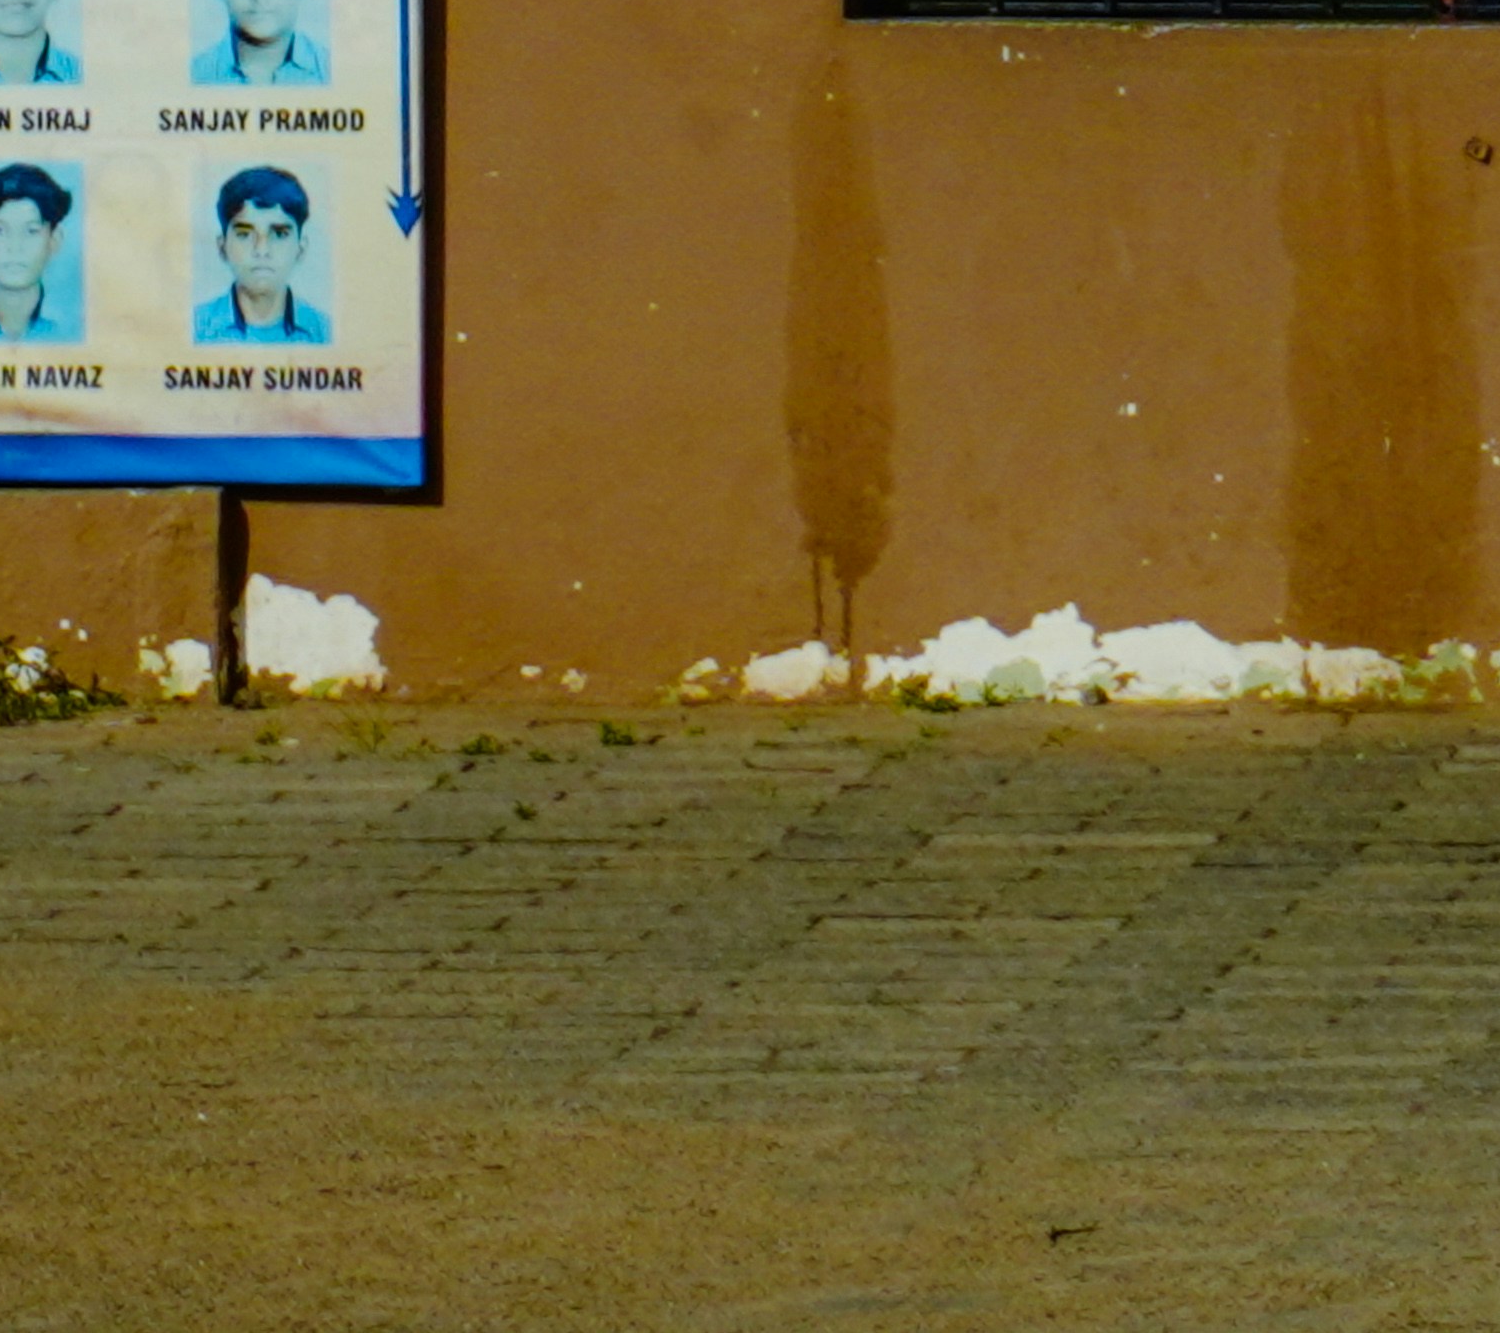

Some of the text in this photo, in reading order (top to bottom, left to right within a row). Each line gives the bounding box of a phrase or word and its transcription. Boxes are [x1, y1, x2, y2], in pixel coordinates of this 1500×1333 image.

[21, 108, 91, 133] SIRAJ
[158, 108, 365, 133] SANJAY PRAMOD
[26, 365, 103, 389] NAVAZ
[164, 365, 363, 392] SANJAY SUNDAR
